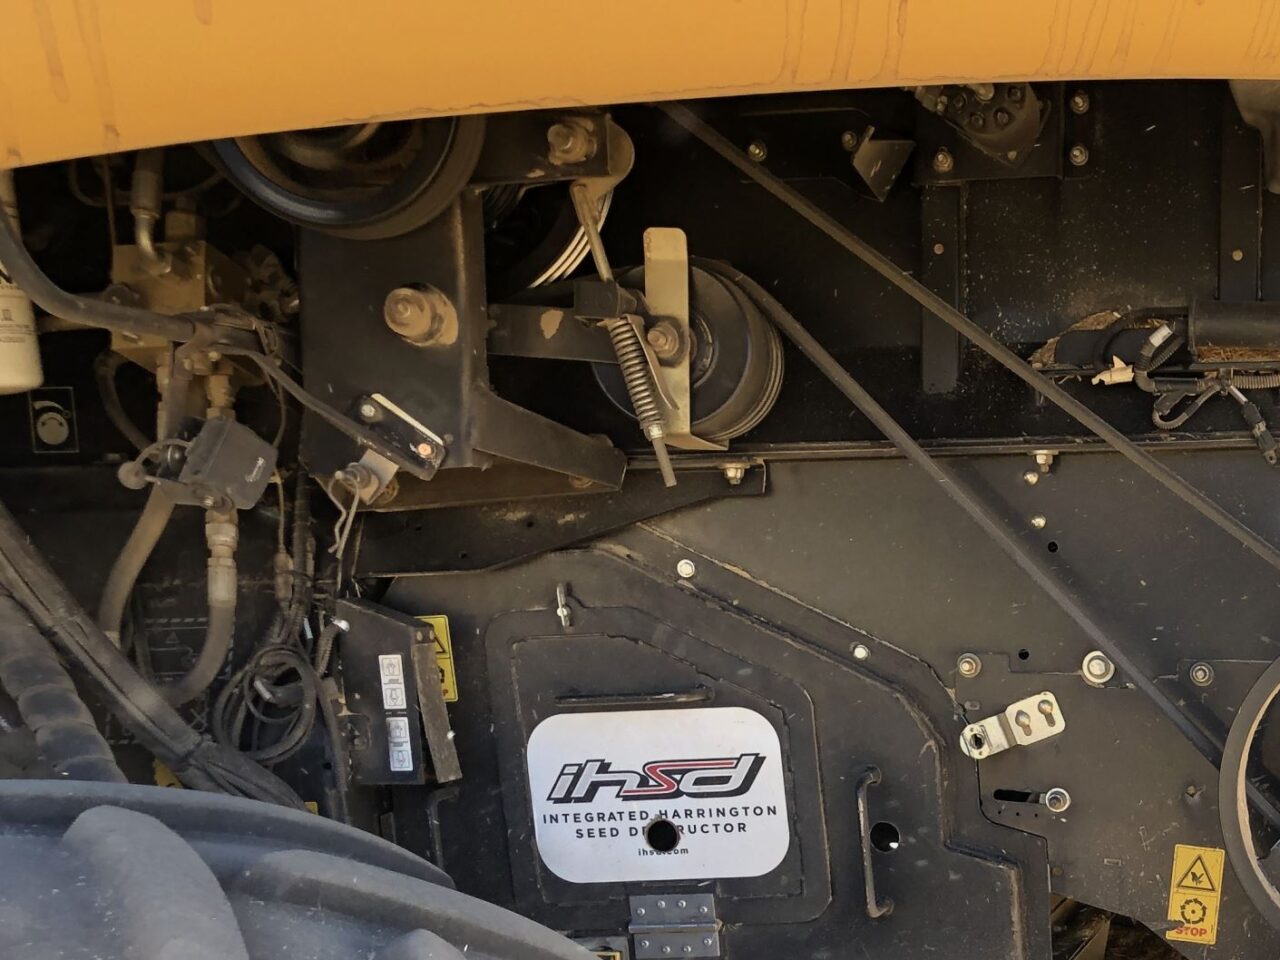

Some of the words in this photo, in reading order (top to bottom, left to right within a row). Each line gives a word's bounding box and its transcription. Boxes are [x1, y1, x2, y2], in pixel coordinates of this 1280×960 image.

[546, 753, 766, 804] ihsd
[543, 810, 649, 824] INTEGRATED
[659, 805, 777, 820] HARRINGTON
[575, 827, 619, 839] SEED
[1175, 926, 1207, 937] STOP
